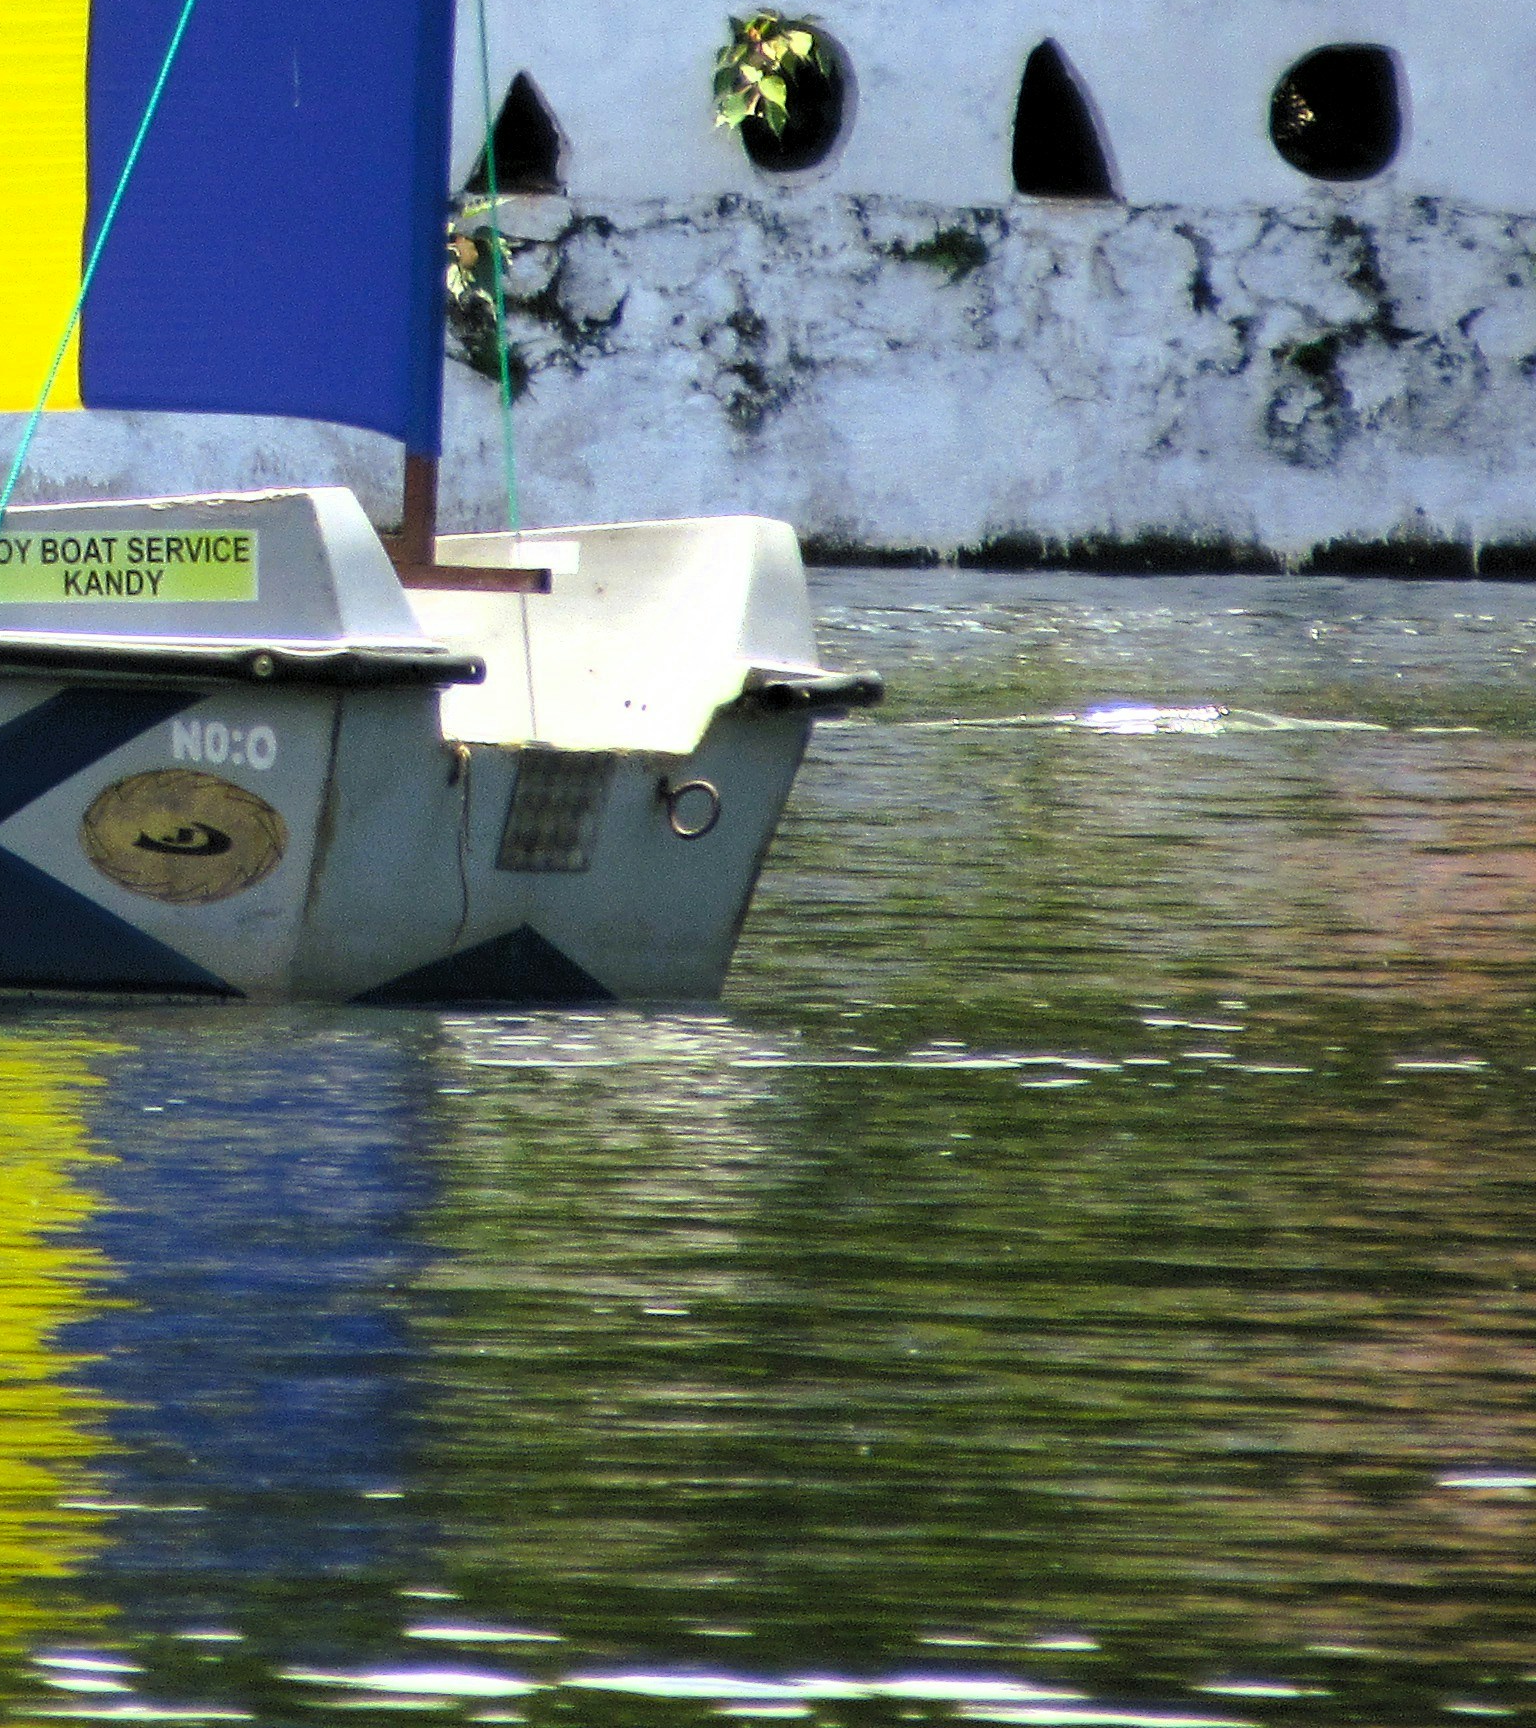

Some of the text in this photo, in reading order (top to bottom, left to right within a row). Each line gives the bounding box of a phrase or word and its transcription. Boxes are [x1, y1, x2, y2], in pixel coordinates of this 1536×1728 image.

[41, 537, 117, 564] BOAT
[127, 536, 250, 563] SERVICE
[64, 569, 164, 596] KANDY
